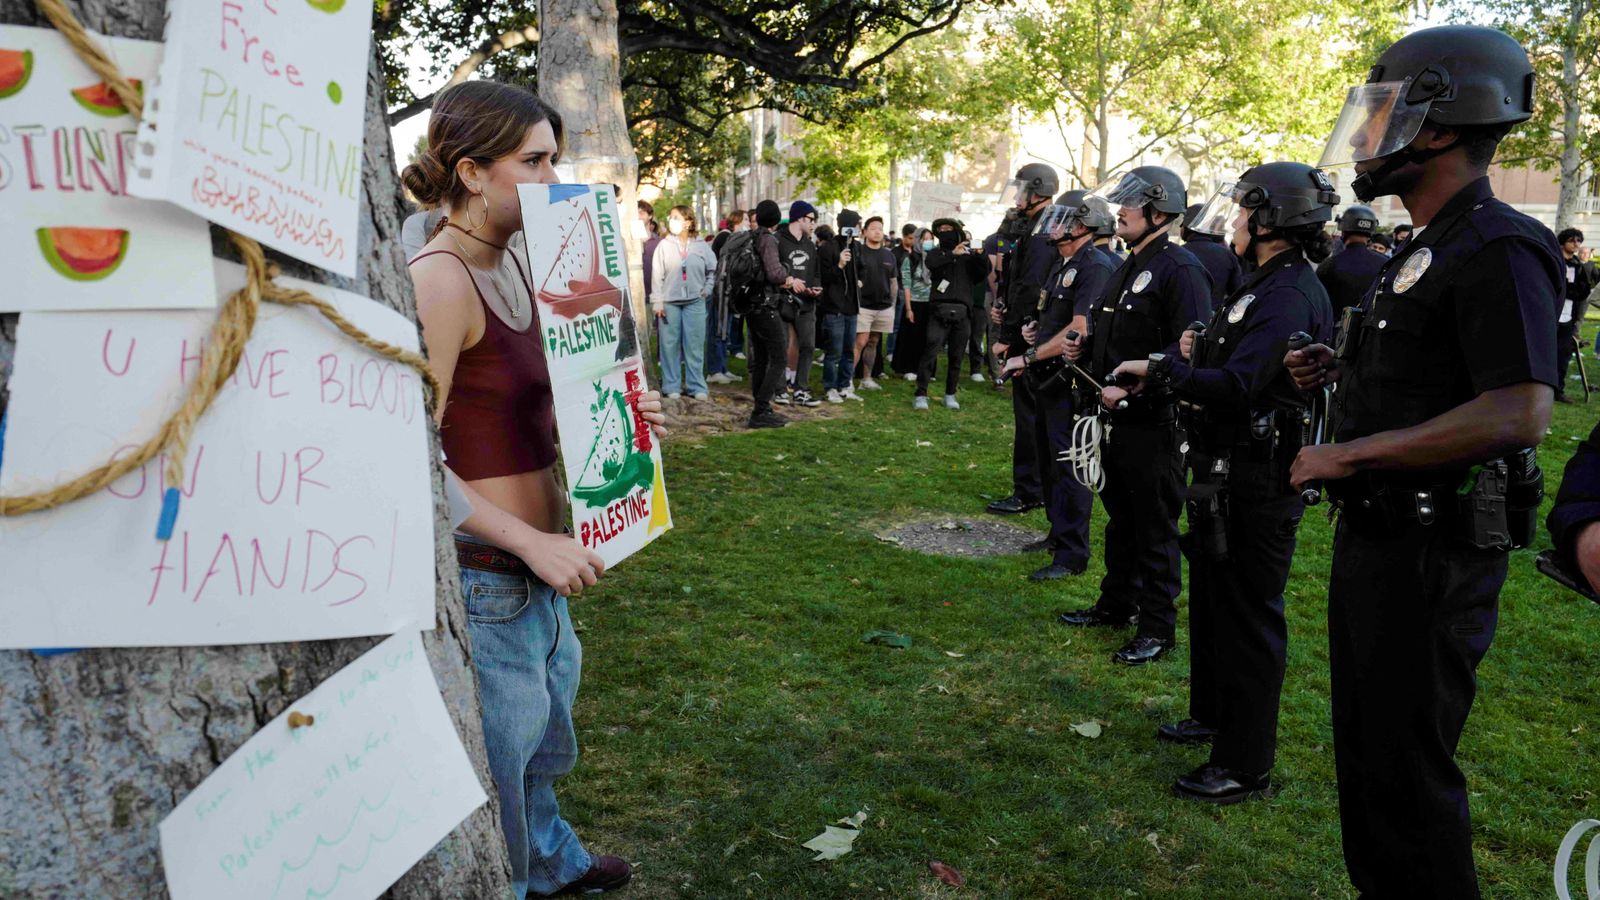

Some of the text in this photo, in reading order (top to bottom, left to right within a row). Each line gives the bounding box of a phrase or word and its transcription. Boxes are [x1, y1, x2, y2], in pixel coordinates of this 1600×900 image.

[220, 1, 305, 87] Free
[199, 67, 359, 201] PALESTINE
[200, 165, 335, 243] BURNING
[595, 191, 622, 278] FREE
[547, 311, 617, 358] PALESTINE
[103, 328, 417, 424] U HVE BLOOD
[256, 446, 331, 506] UR
[580, 488, 650, 549] PALESTINE
